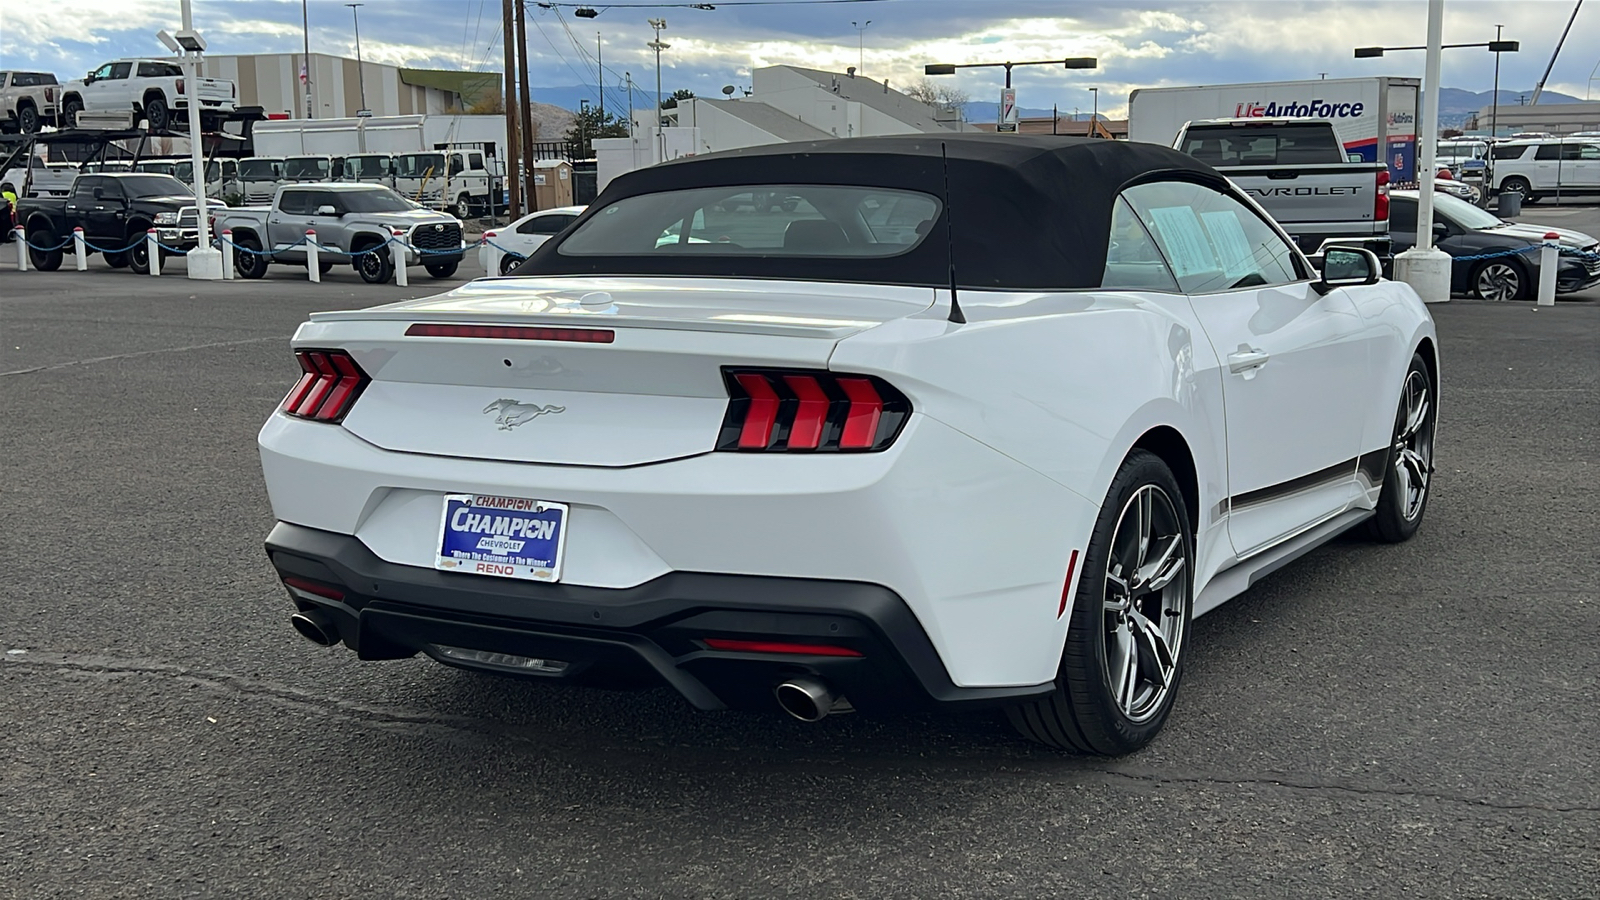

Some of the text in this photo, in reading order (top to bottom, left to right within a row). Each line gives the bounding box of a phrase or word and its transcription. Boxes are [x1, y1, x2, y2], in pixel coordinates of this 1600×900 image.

[1244, 186, 1362, 197] EVROLET
[476, 496, 533, 510] CHAMPION
[451, 508, 556, 540] CHAMPION
[480, 539, 521, 550] CHEVROLET
[471, 552, 482, 560] The
[482, 554, 508, 563] Customer
[516, 556, 526, 565] The
[476, 563, 514, 576] RENO
